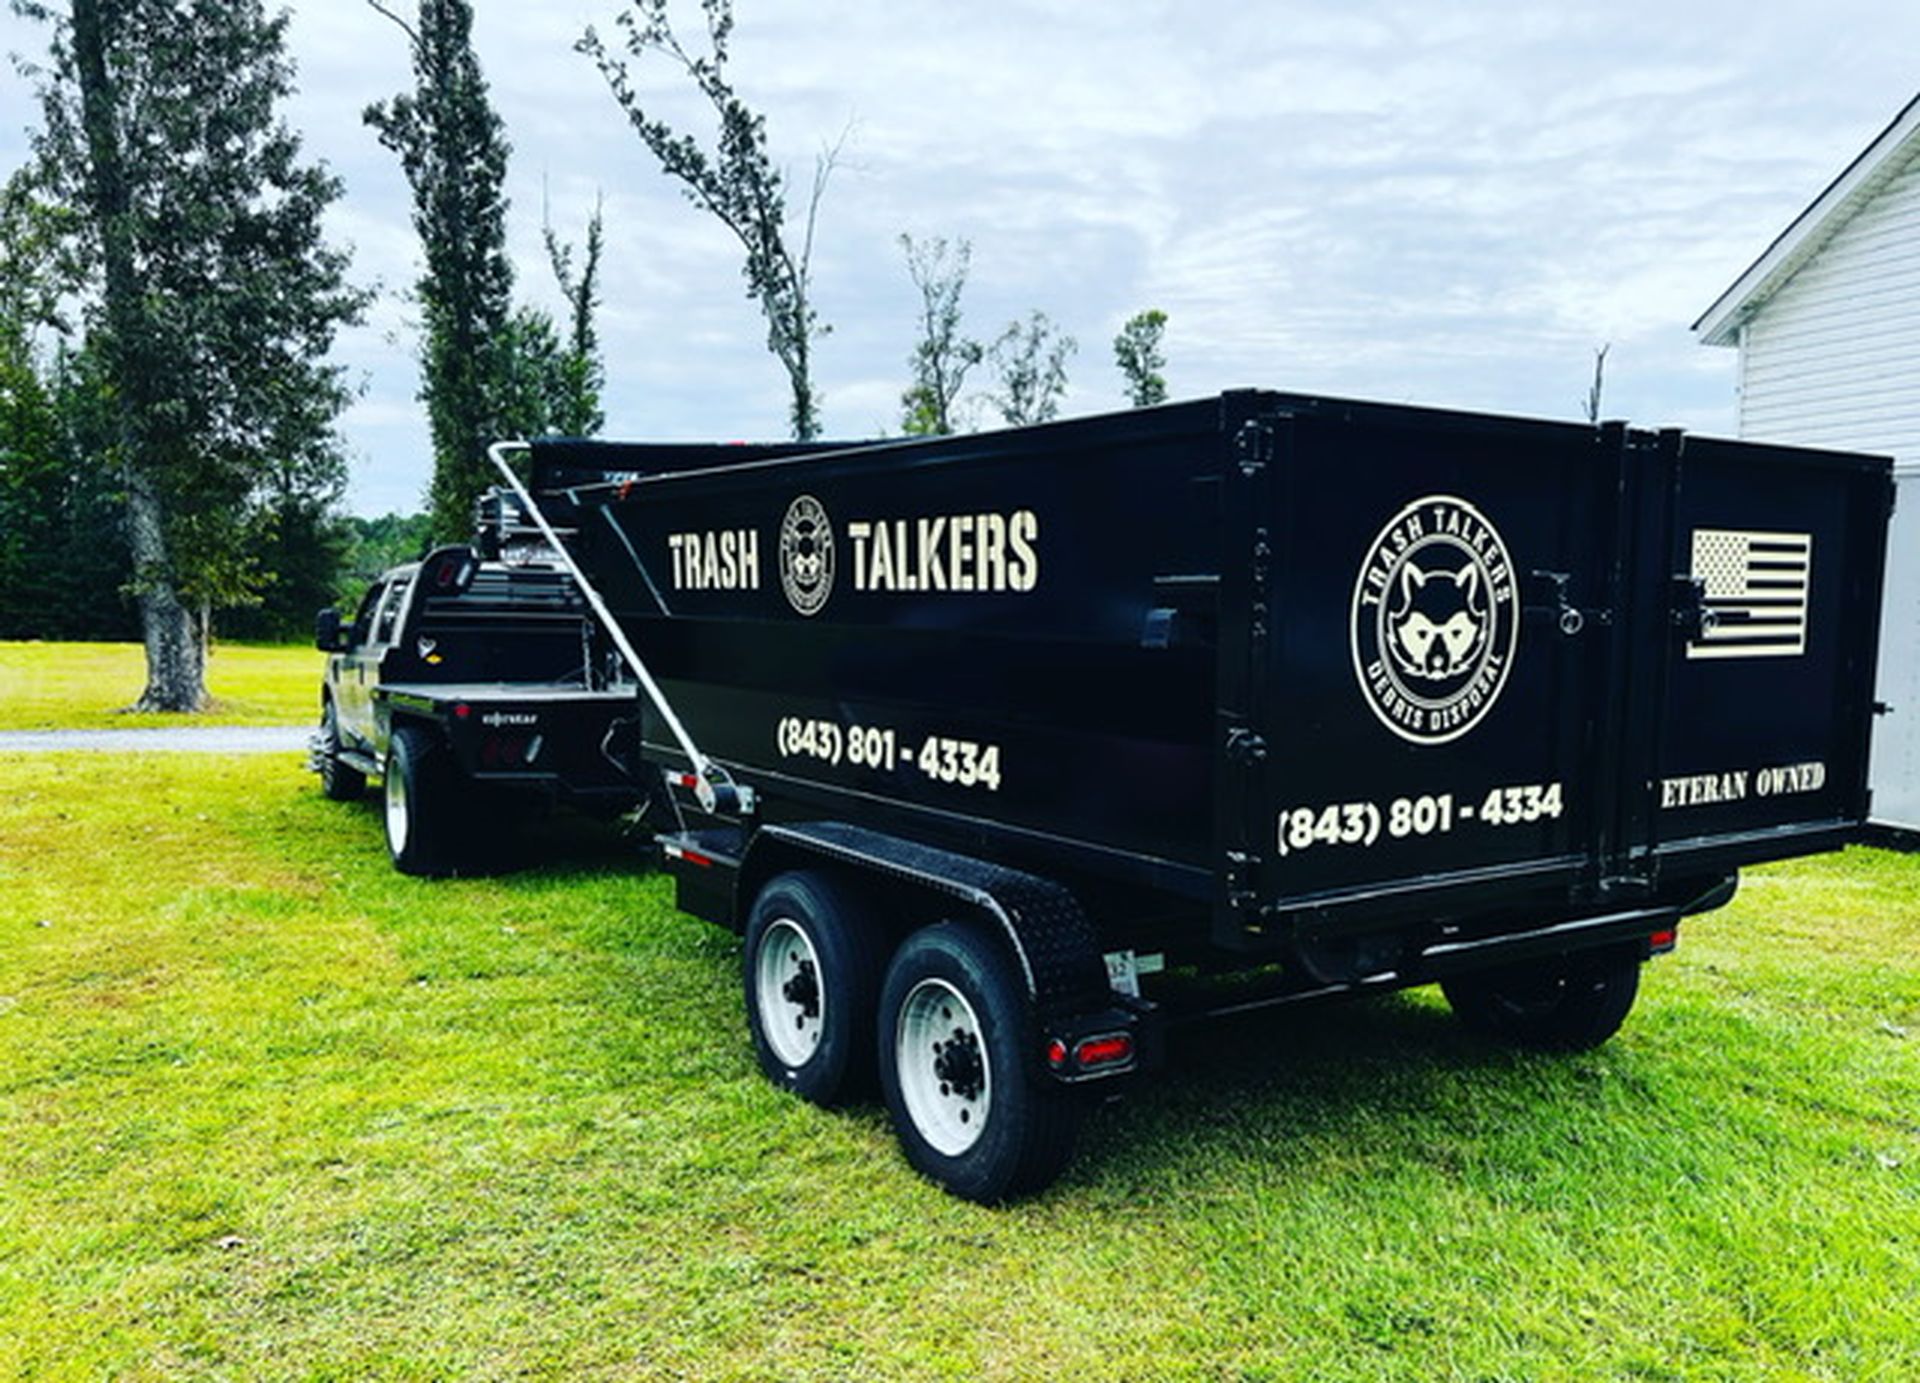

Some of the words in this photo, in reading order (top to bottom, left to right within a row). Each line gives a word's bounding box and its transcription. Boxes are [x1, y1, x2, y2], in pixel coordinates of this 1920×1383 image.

[669, 530, 759, 589] TRASH
[849, 510, 1038, 591] TALKERS
[1362, 514, 1423, 606] TRASH
[1433, 506, 1511, 603] TALKERS
[1367, 659, 1423, 730] DEBRIS
[1430, 654, 1503, 731] DISPOSAL
[777, 717, 842, 766] (843)
[848, 725, 895, 771] 801
[918, 736, 1001, 790] 4334
[1647, 770, 1749, 808] ETERAN
[1756, 762, 1826, 797] OWNED
[1279, 809, 1381, 856] (843)
[1389, 794, 1452, 838] 801
[1481, 783, 1563, 826] 4334
